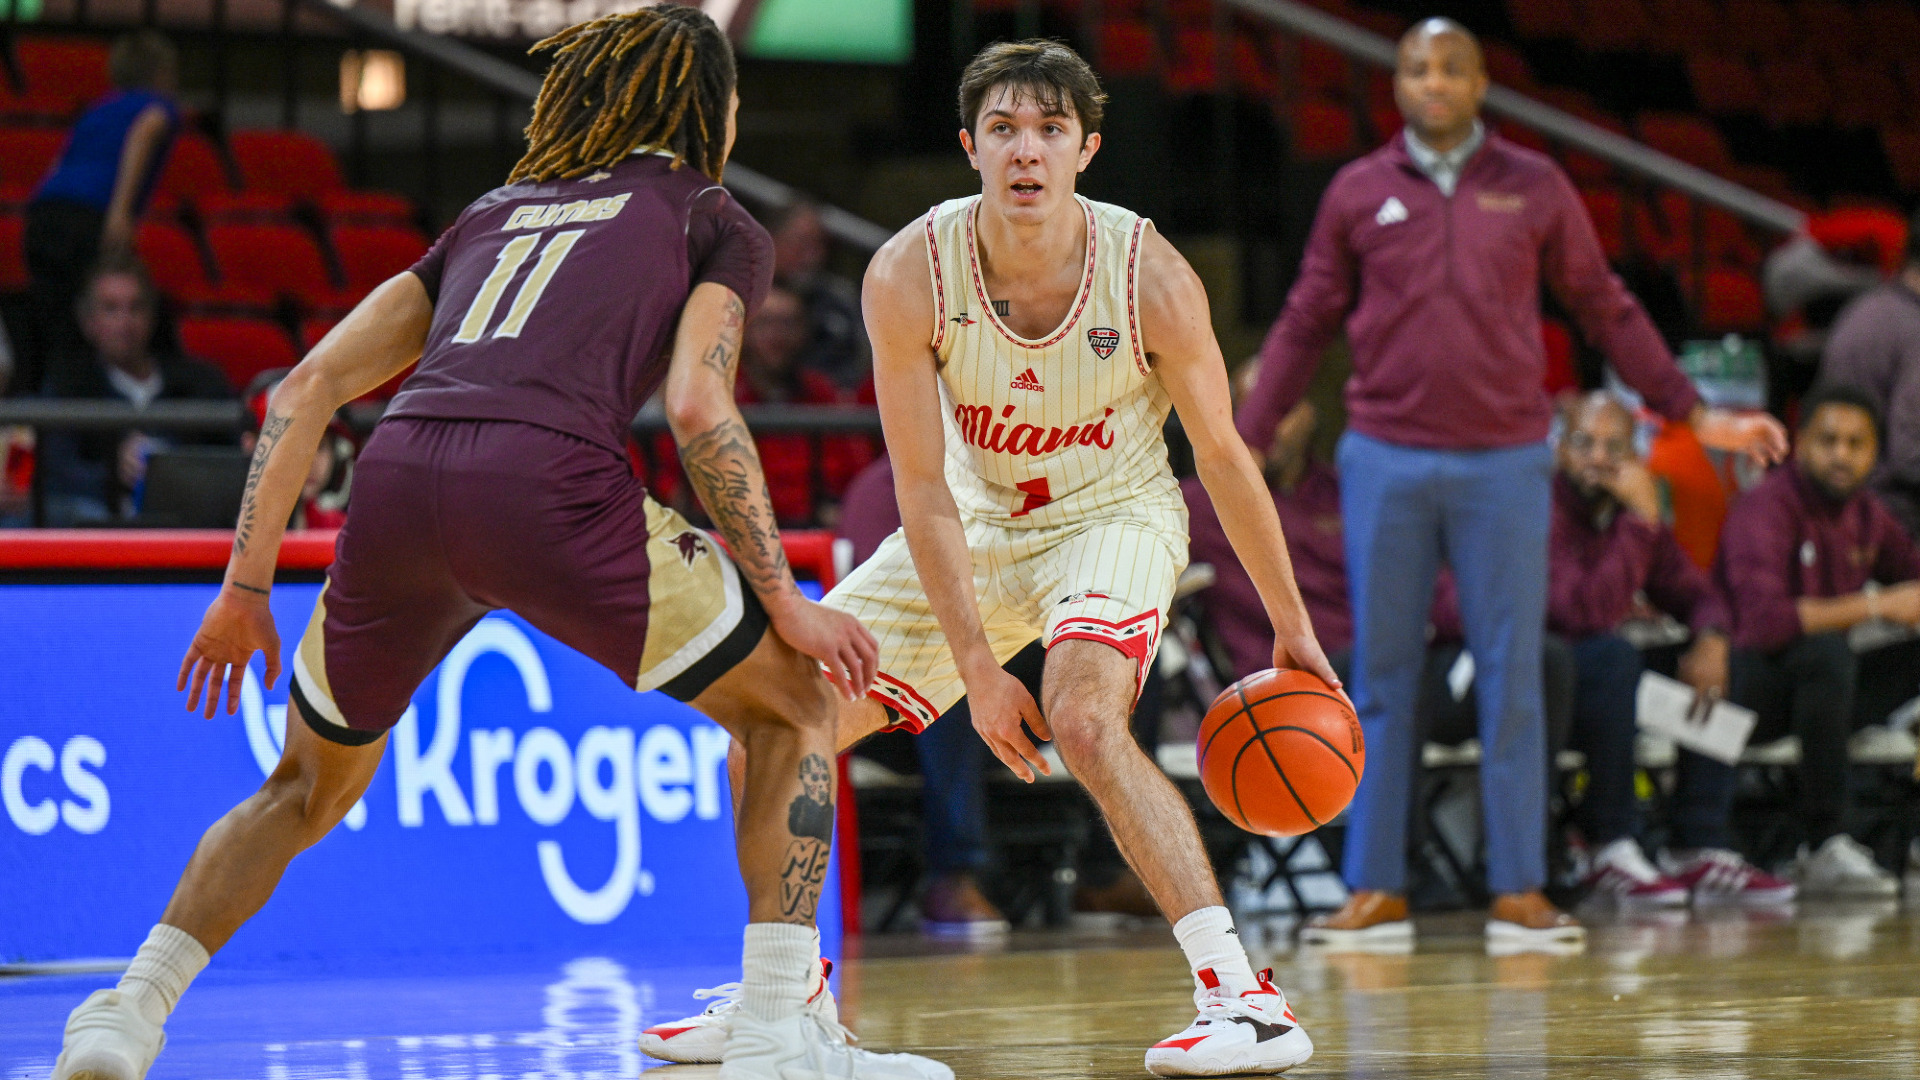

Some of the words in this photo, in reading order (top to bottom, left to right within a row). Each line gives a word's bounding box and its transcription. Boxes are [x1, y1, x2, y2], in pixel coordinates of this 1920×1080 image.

[501, 192, 633, 231] GUMBS
[451, 229, 586, 343] 11
[1090, 337, 1118, 347] MAC
[1010, 380, 1045, 393] adidas
[954, 403, 1115, 456] Miami
[1011, 477, 1053, 518] 1
[394, 618, 731, 926] Kroger
